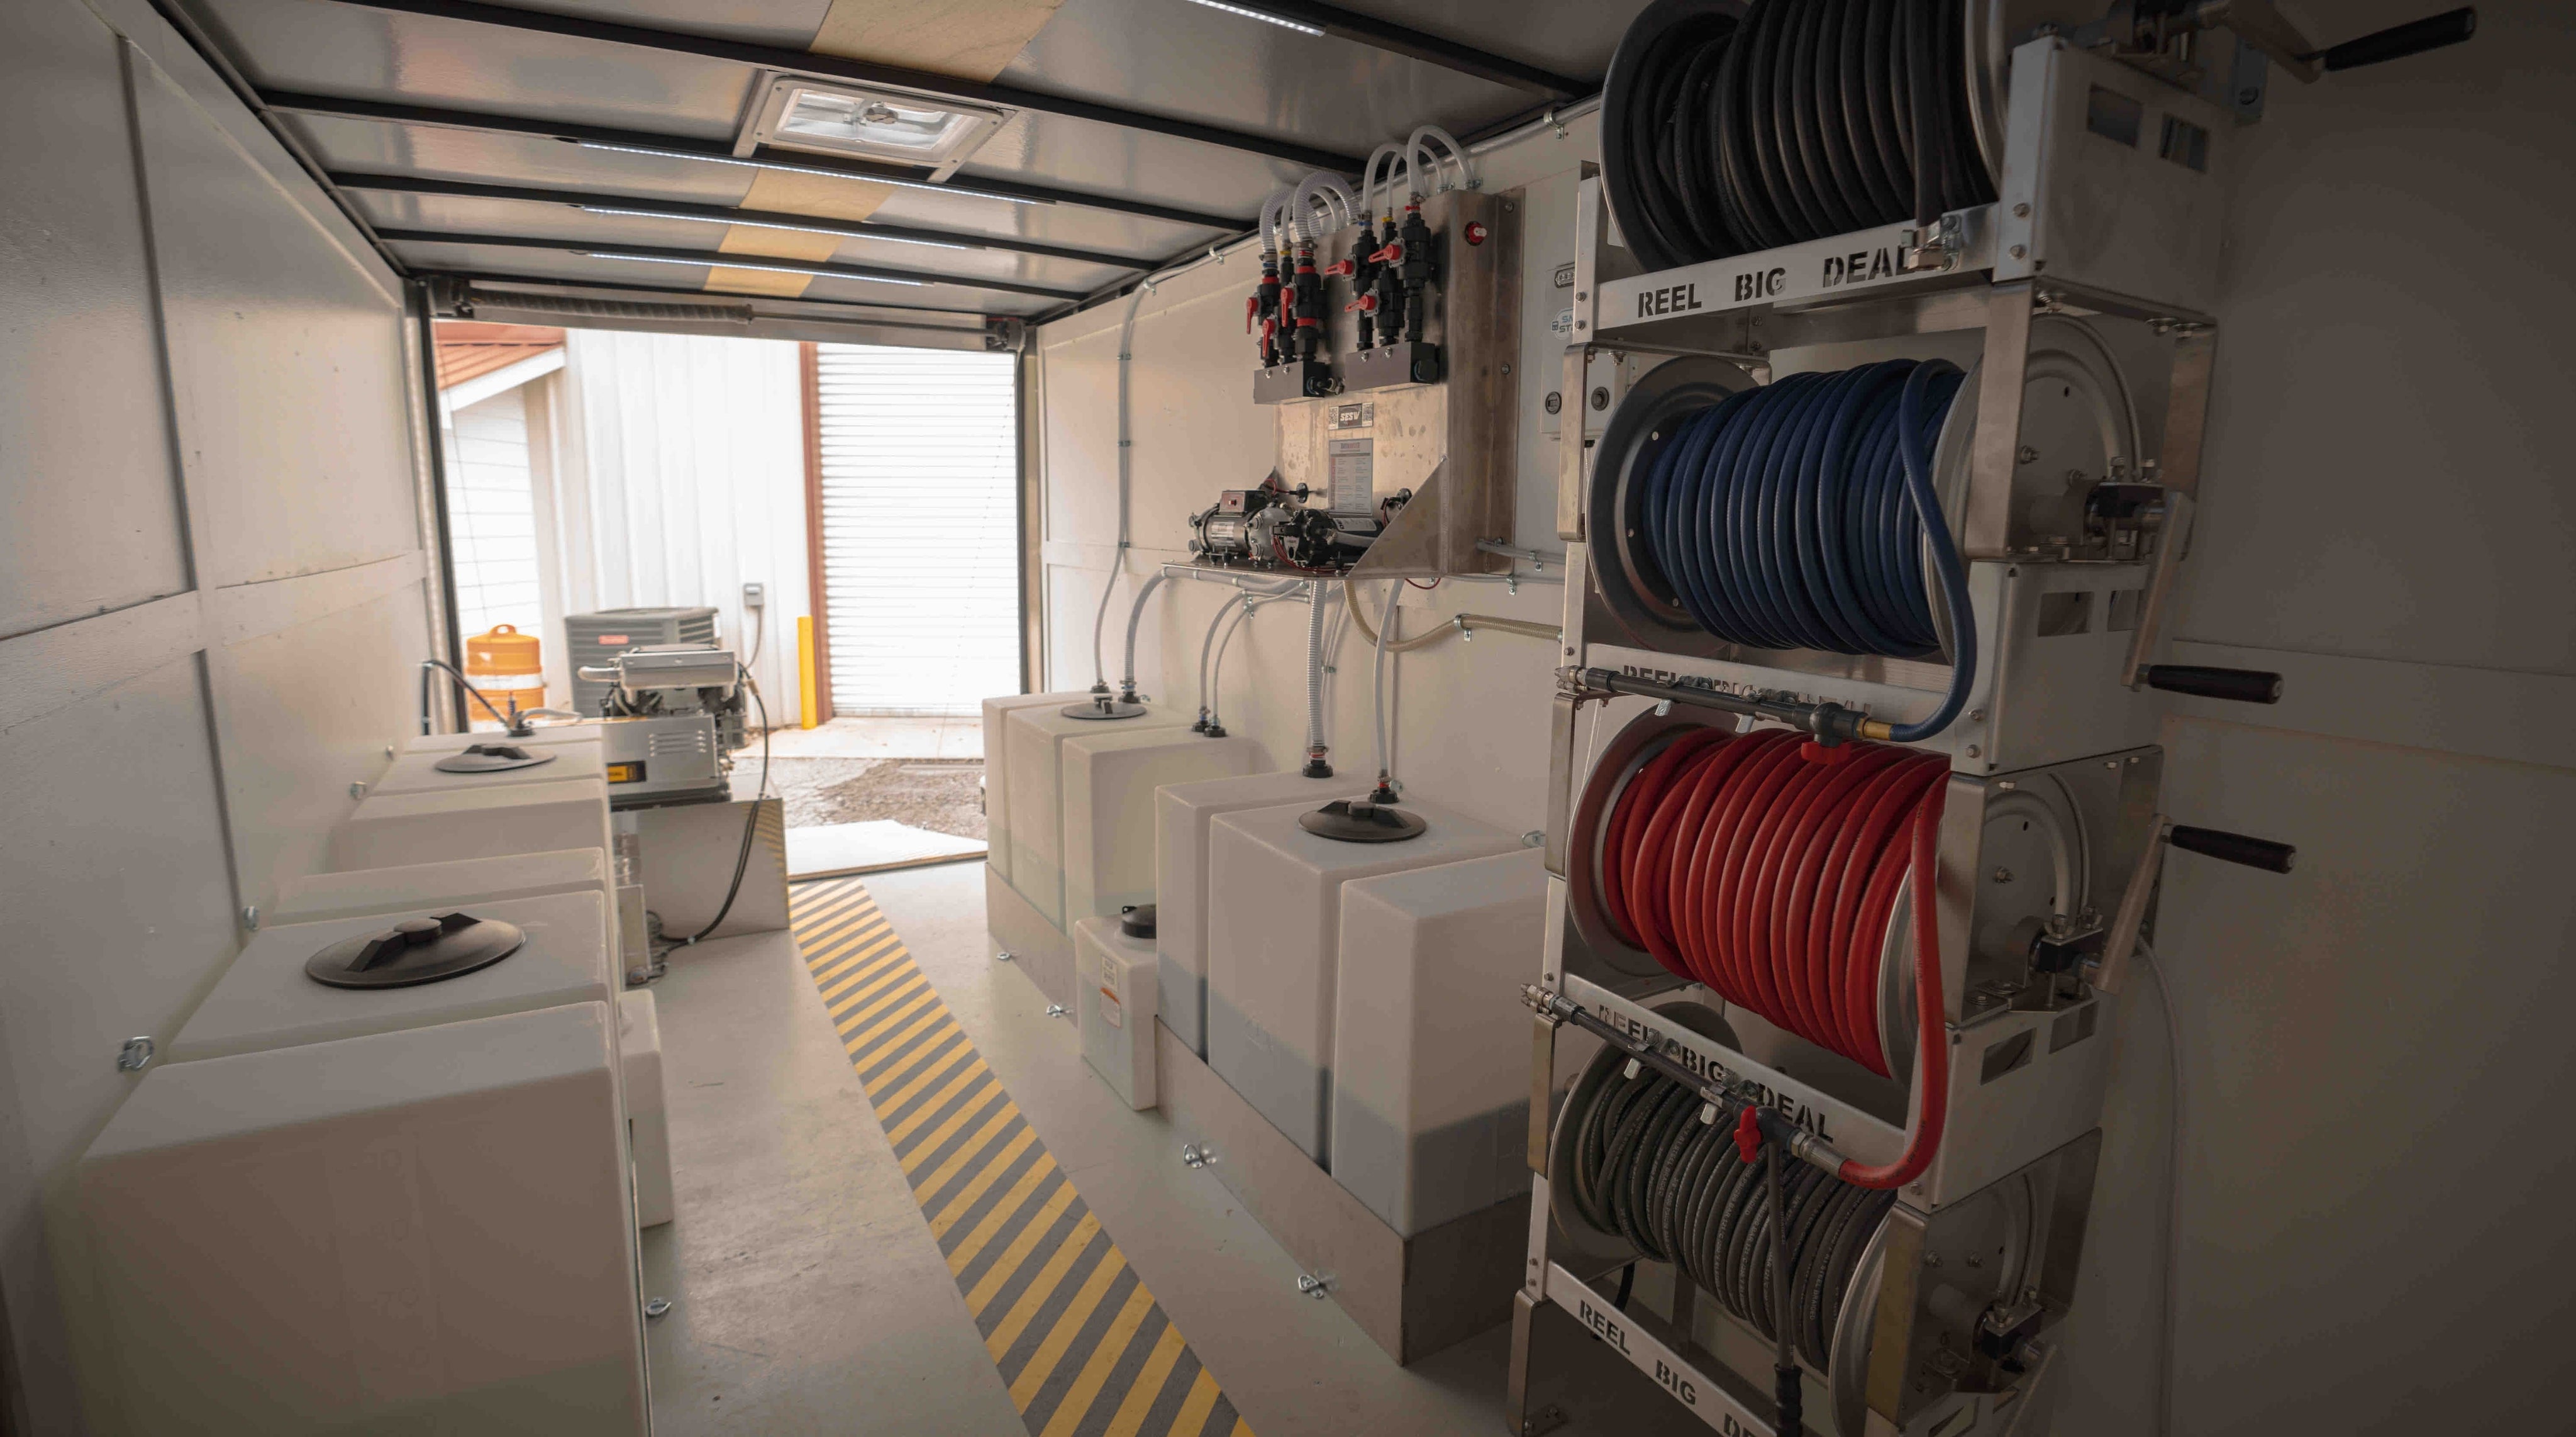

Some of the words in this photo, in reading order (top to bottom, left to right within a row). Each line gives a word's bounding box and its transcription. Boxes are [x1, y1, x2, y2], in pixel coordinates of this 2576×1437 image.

[1638, 284, 1702, 318] REEL
[1735, 267, 1787, 302] BIG
[1823, 245, 1916, 288] DEAL
[1682, 1046, 1724, 1082] BIG
[1757, 1082, 1834, 1143] DEAL
[1580, 1299, 1631, 1356] REEL
[1656, 1360, 1696, 1406] BIG
